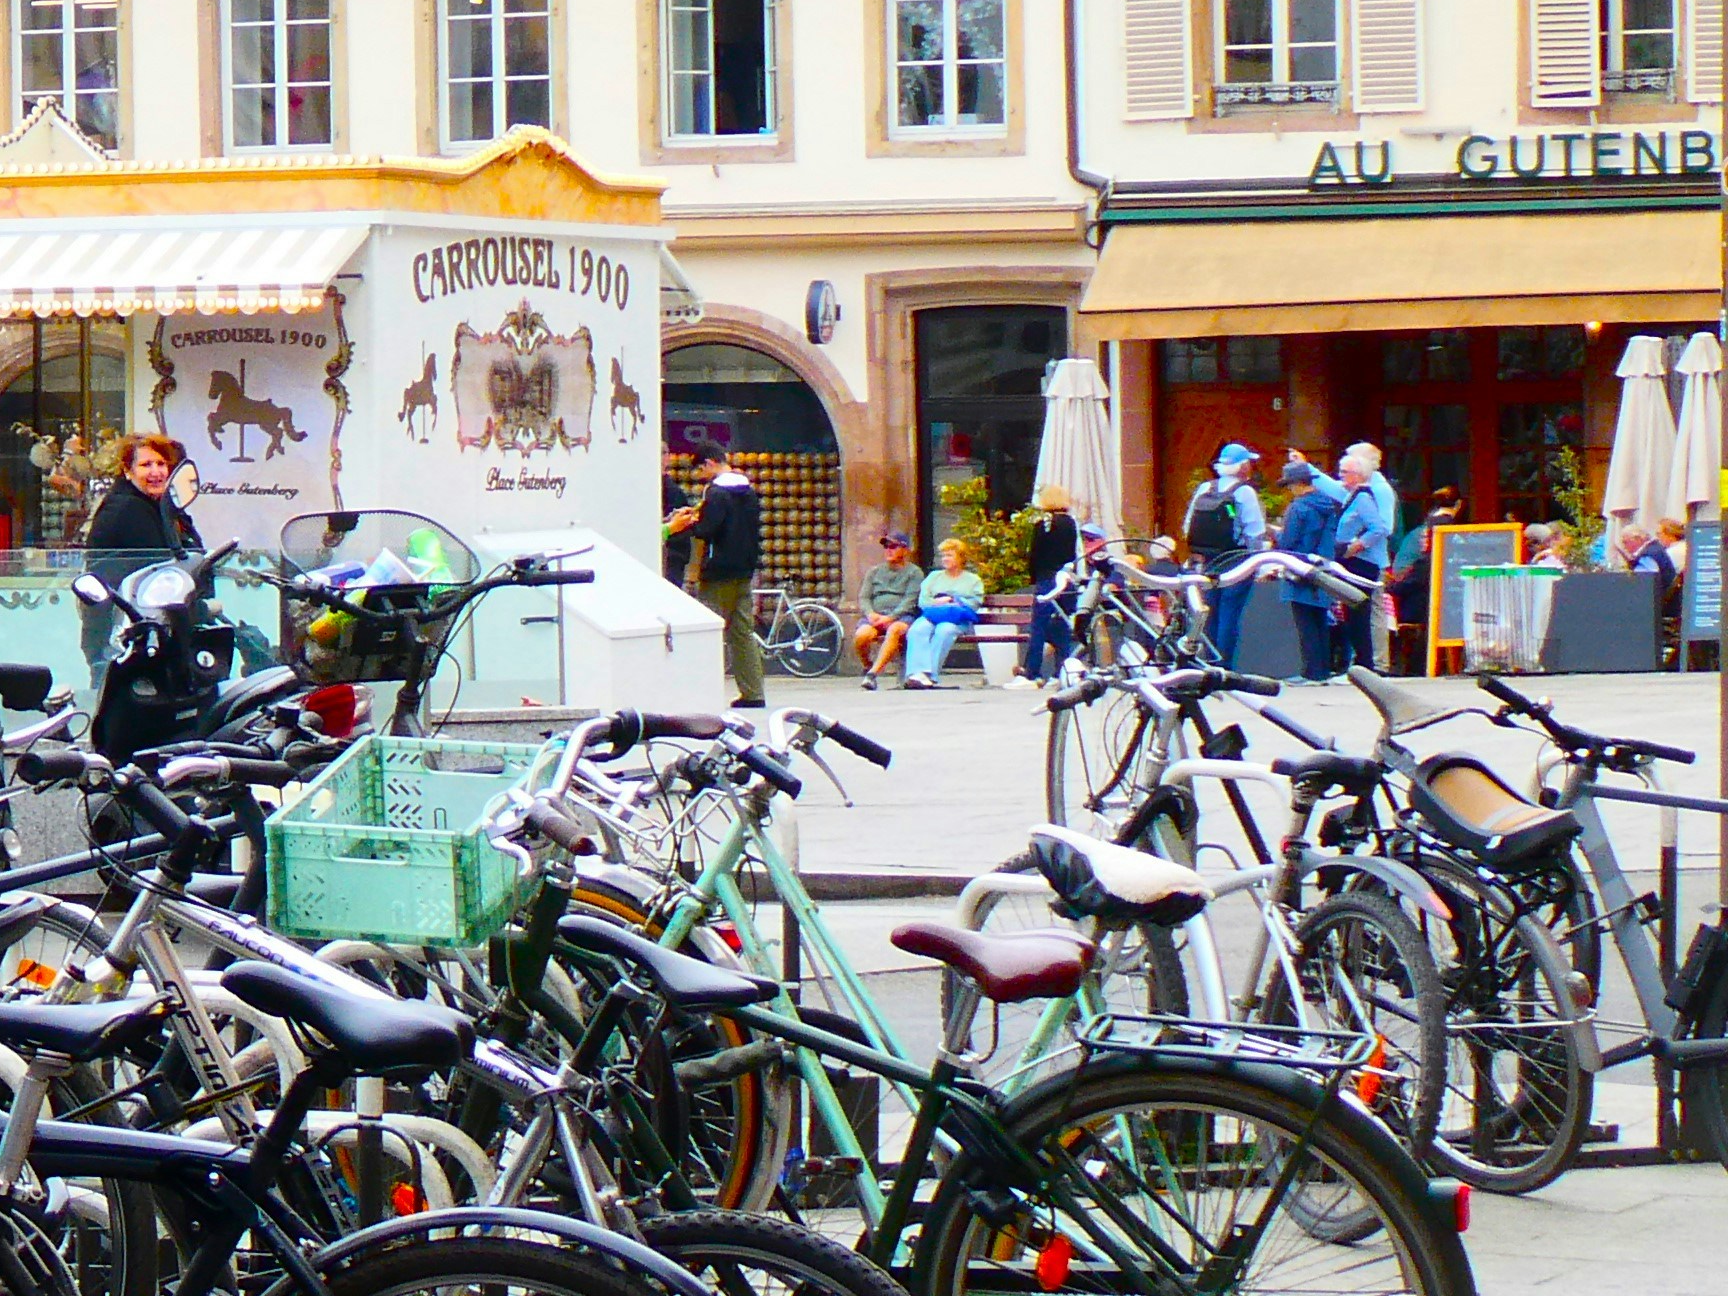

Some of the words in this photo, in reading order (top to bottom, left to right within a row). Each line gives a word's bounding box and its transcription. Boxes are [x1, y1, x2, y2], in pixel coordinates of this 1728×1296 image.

[1309, 140, 1393, 185] AU
[1456, 131, 1716, 180] GUTENB
[411, 234, 561, 304] CARROUSEL
[568, 245, 630, 311] 1900
[170, 327, 275, 349] CARROUSEL
[280, 328, 328, 350] 1900
[236, 482, 300, 501] Gutenberg
[485, 467, 516, 492] Place
[517, 466, 567, 499] Gutenberg
